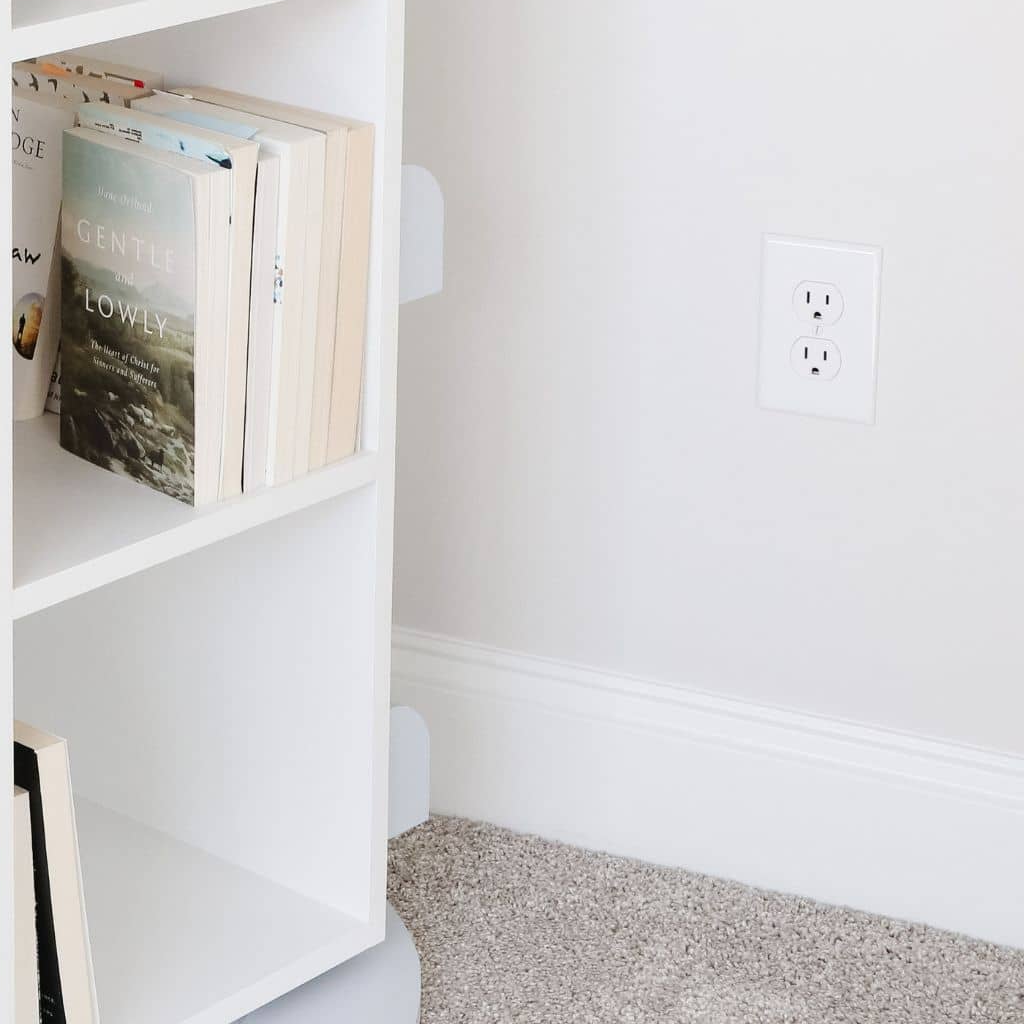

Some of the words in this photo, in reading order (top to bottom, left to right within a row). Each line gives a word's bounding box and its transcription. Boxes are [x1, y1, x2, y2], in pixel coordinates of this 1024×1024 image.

[77, 219, 175, 273] GENTLE
[85, 288, 167, 339] LOWLY
[90, 338, 102, 352] The
[103, 343, 121, 358] Heart
[122, 353, 129, 364] of
[130, 354, 150, 370] Christ
[150, 363, 160, 374] for
[93, 356, 115, 372] Sinners
[117, 366, 128, 377] and
